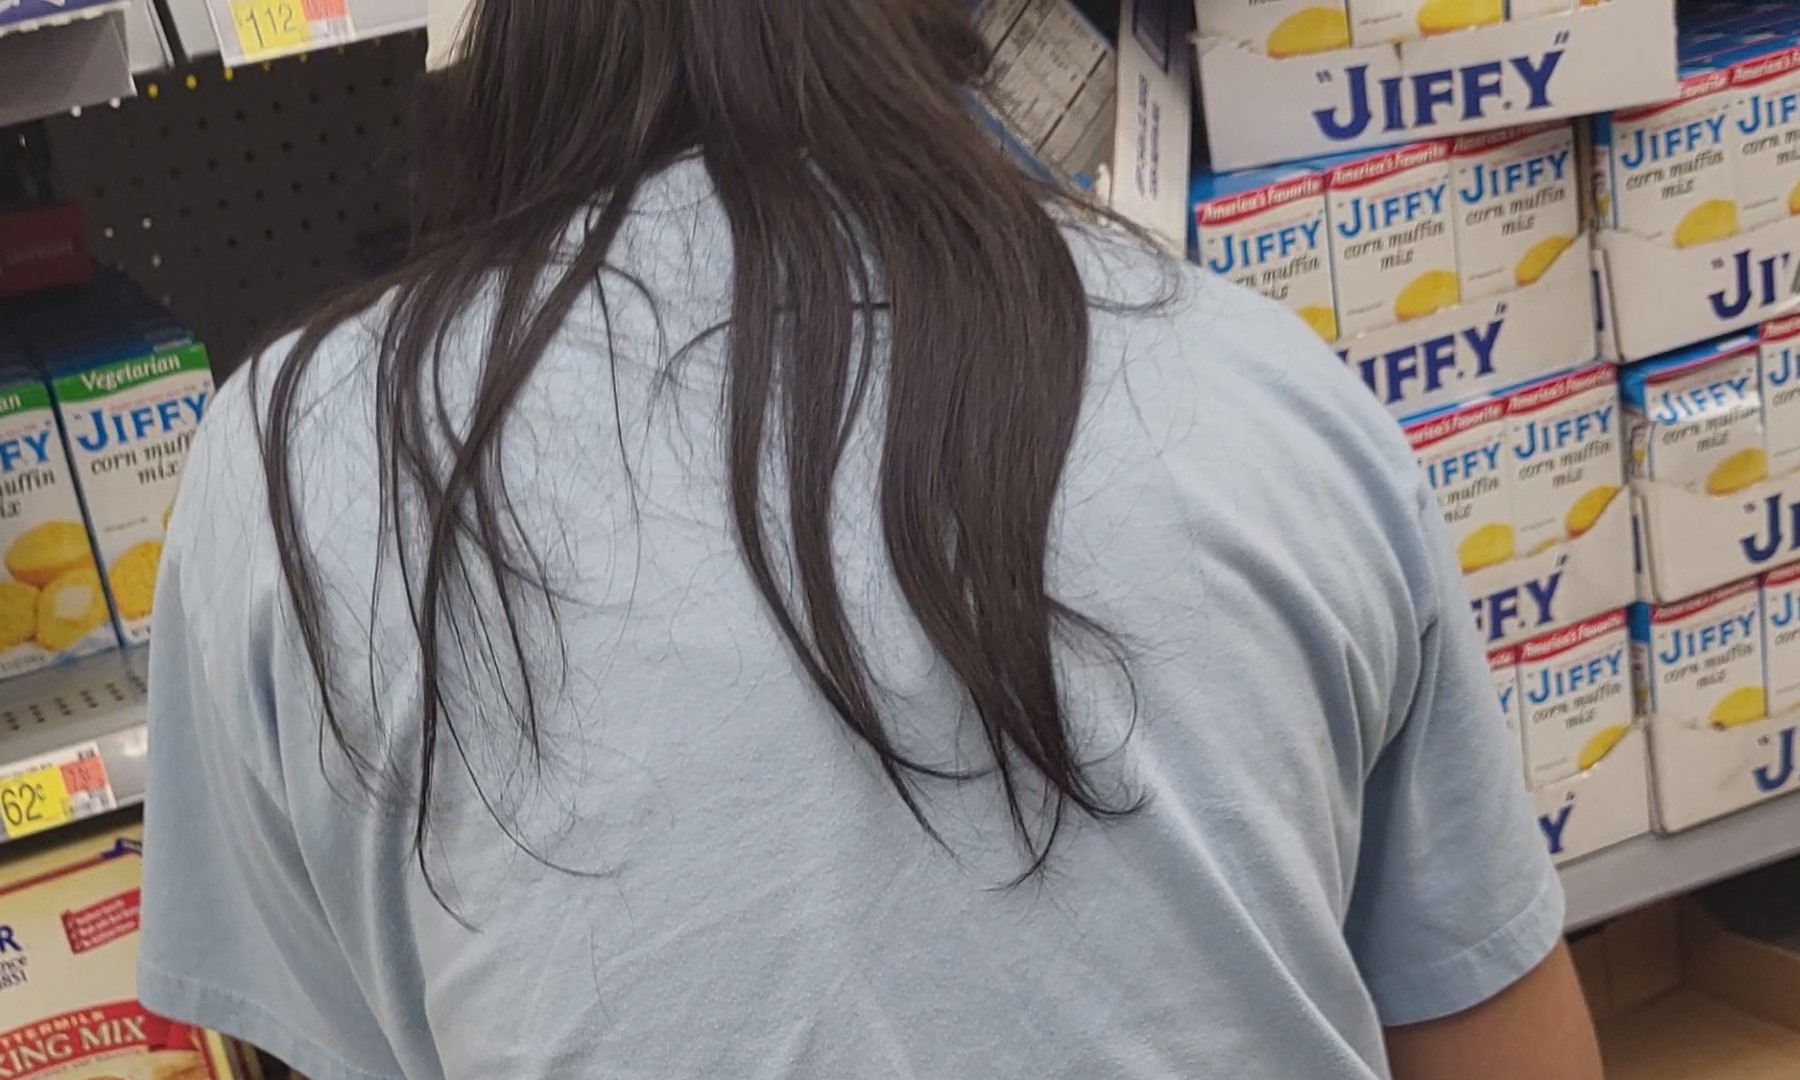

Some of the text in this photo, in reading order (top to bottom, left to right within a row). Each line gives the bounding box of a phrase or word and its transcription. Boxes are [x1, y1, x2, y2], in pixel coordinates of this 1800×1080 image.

[81, 354, 181, 392] Vegetarian
[1337, 303, 1507, 406] IFFY"
[91, 430, 196, 475] corn muff
[138, 460, 179, 485] mix
[1427, 441, 1501, 490] IFFY
[79, 1015, 147, 1051] MIX
